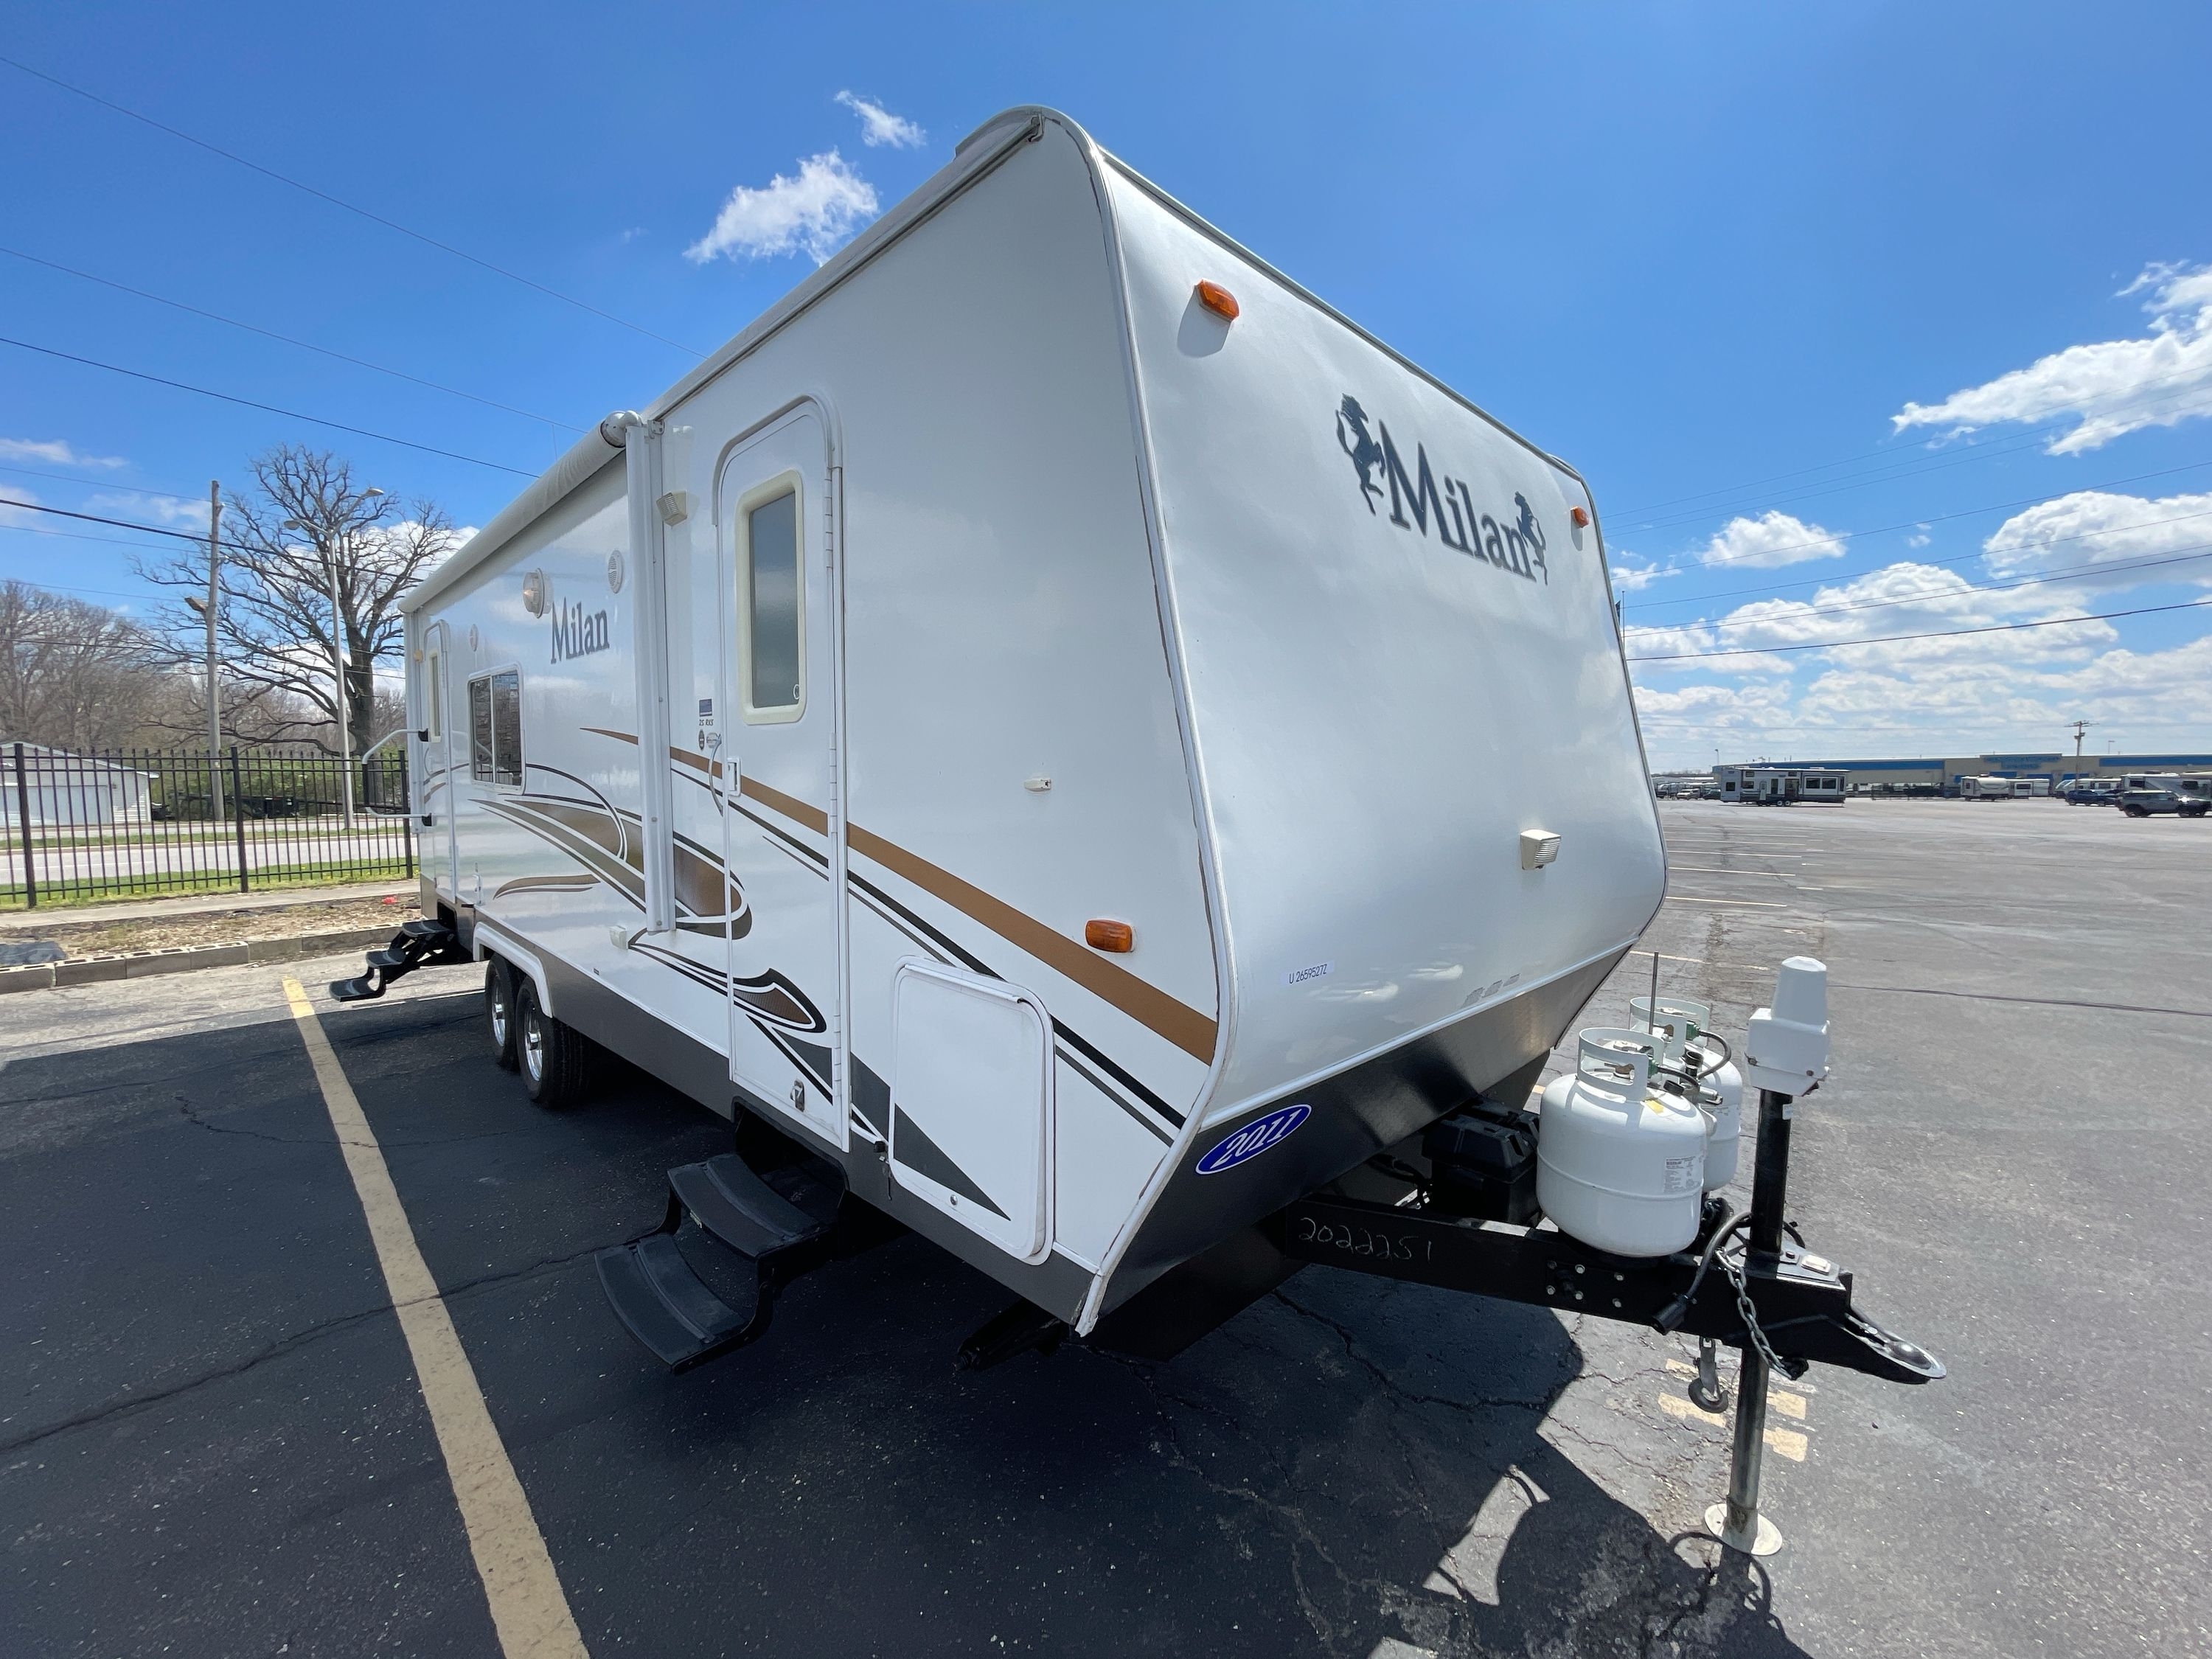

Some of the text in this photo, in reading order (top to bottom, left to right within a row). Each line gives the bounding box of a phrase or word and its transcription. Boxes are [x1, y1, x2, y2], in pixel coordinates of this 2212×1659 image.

[1378, 419, 1537, 582] Milan
[551, 596, 610, 664] Milan
[1289, 973, 1295, 984] U
[1209, 1109, 1302, 1169] 2011
